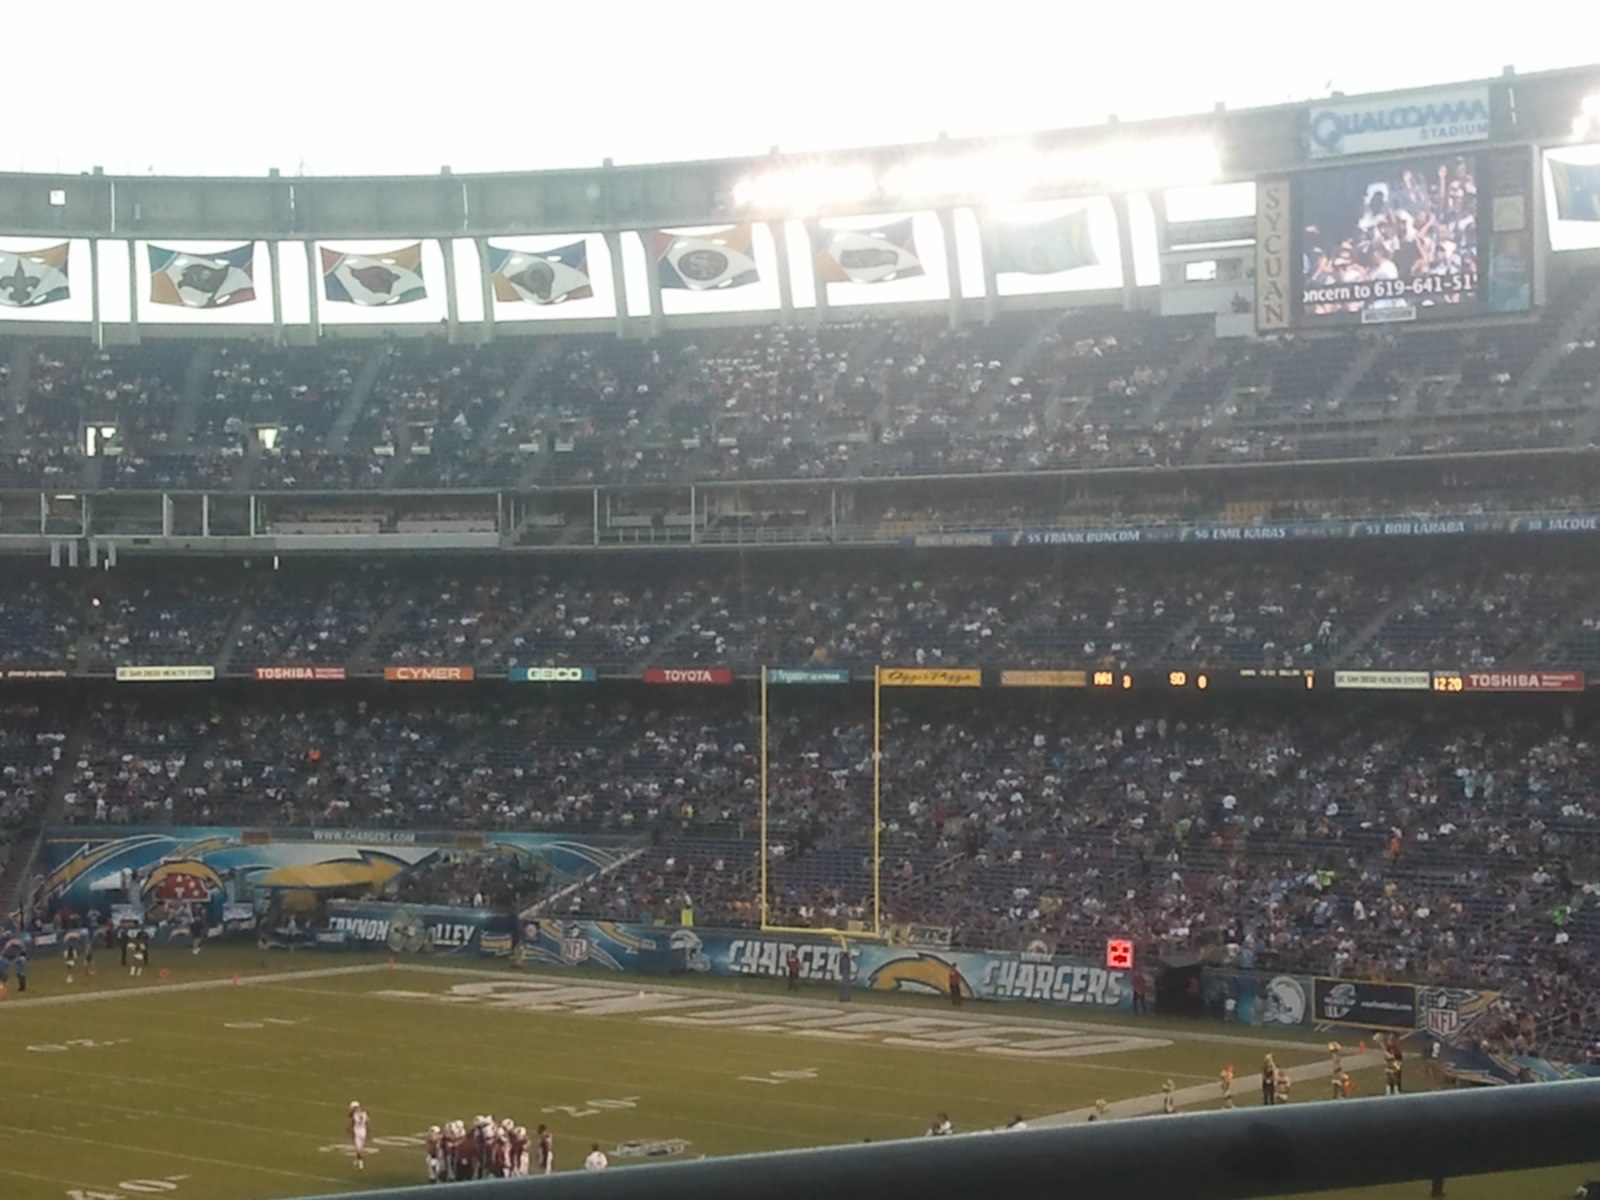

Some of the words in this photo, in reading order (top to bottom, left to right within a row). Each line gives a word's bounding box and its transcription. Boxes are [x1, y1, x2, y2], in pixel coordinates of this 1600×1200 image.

[1311, 99, 1489, 152] QUALCOMM
[1420, 124, 1488, 140] STADIUM
[1263, 188, 1284, 324] SYCUAN
[1354, 284, 1371, 298] to
[1374, 274, 1478, 297] 619-641-51
[256, 668, 314, 679] TOSHIBA
[396, 667, 461, 680] CYMER
[527, 667, 582, 680] GEICO
[664, 670, 712, 682] TOYOTA
[1347, 675, 1359, 684] SAN
[1361, 675, 1377, 684] DIEGO
[1379, 675, 1402, 684] HEALTH
[1469, 674, 1540, 688] TOSHIBA
[313, 831, 416, 843] WWW.CHARGERS.COM
[564, 938, 587, 959] NFL
[983, 961, 1125, 1005] CHARGERS
[1430, 1009, 1455, 1032] NFL
